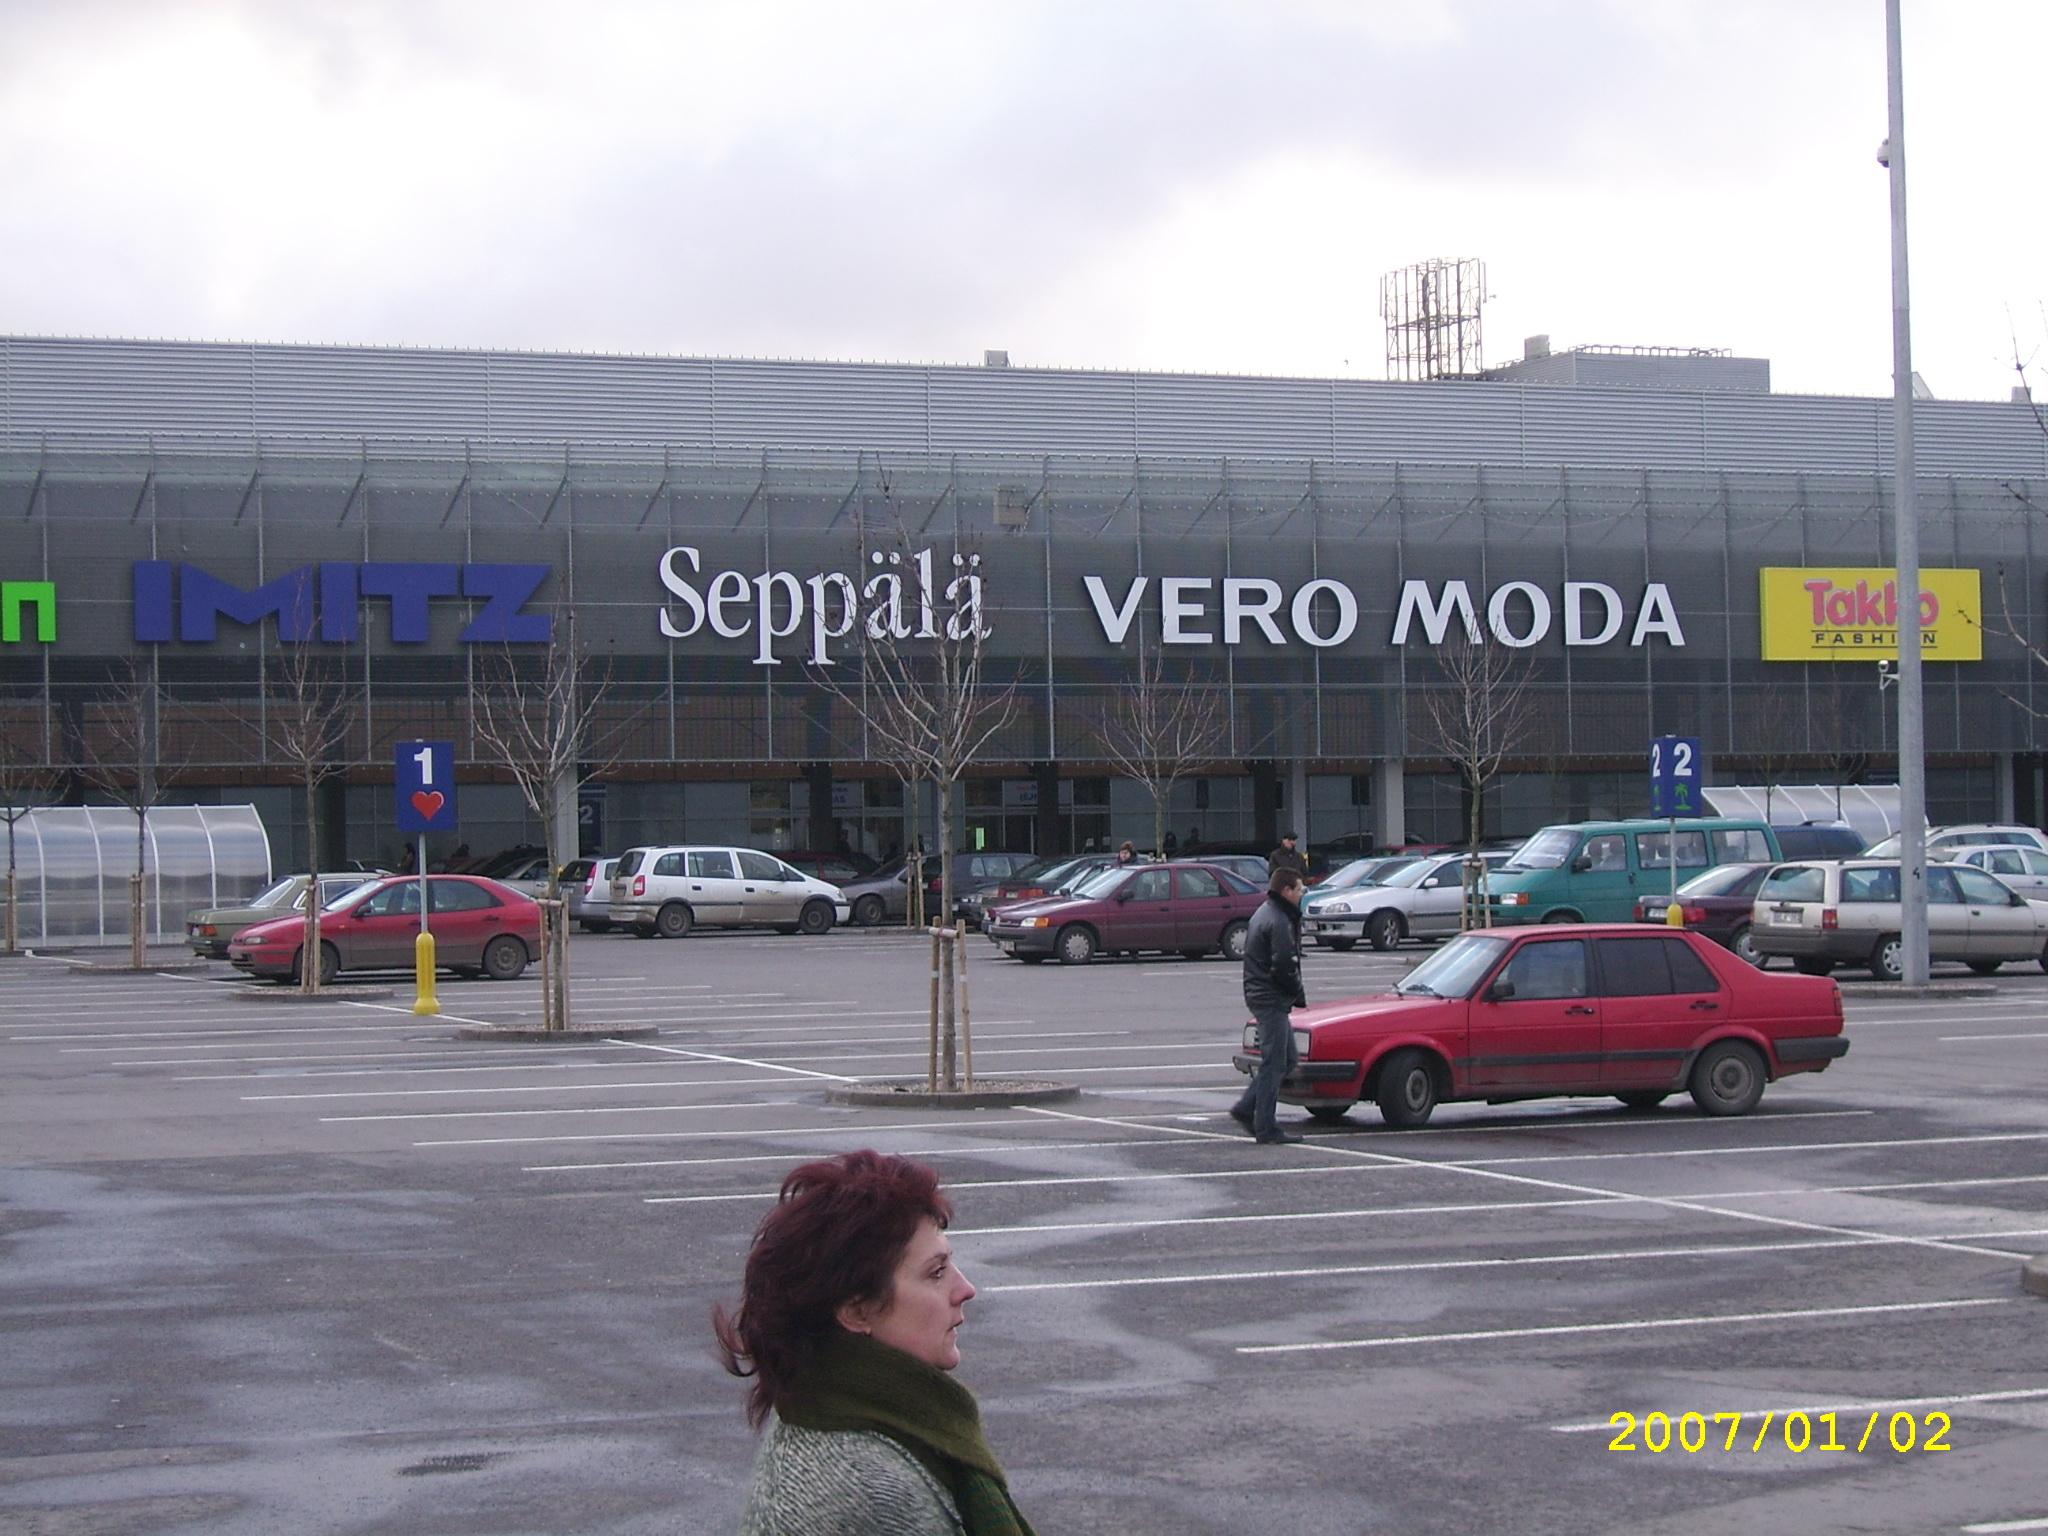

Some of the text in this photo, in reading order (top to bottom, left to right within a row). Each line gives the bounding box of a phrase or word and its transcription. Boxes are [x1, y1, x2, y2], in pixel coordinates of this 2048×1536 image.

[134, 560, 553, 644] IMITZ
[658, 546, 992, 666] Seppälä
[1083, 577, 1686, 648] VERO MODA
[1815, 632, 1937, 645] FASHIN
[413, 746, 434, 786] 1
[1652, 742, 1661, 778] 2
[1673, 742, 1693, 776] 2
